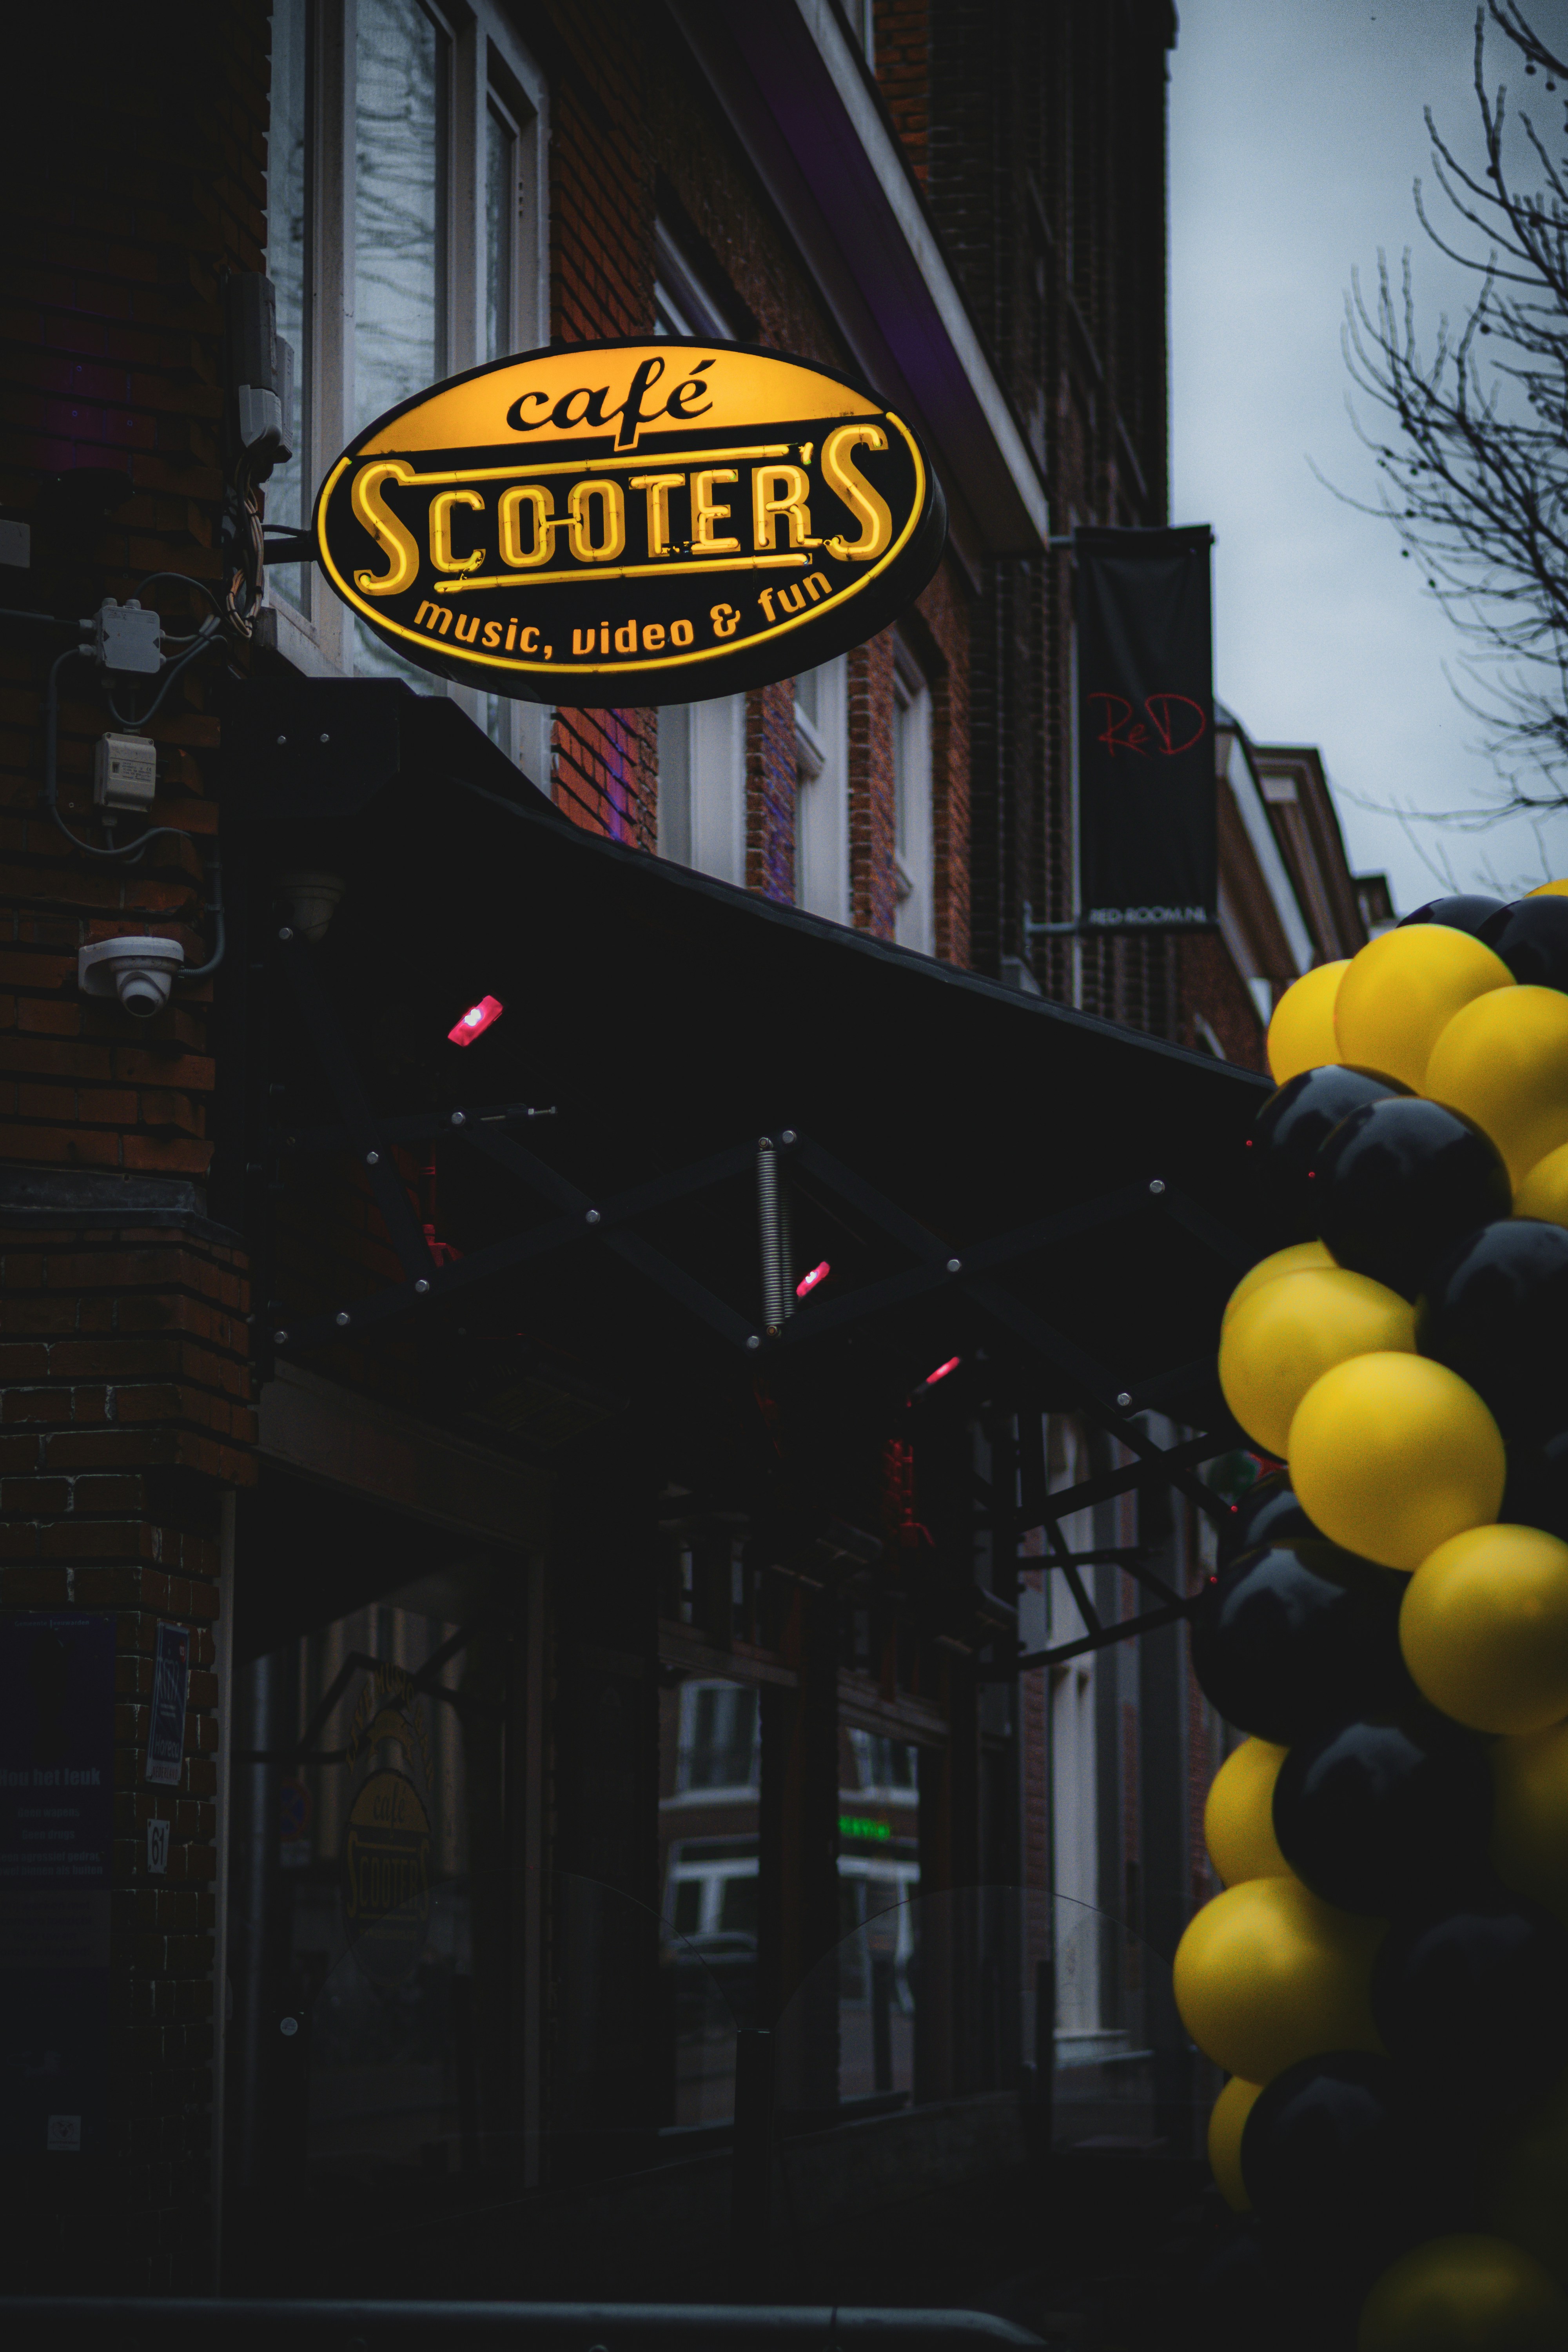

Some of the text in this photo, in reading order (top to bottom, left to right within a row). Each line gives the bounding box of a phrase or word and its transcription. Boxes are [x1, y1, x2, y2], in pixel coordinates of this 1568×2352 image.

[506, 356, 717, 452] café
[351, 424, 893, 596] SCOOTER'S
[414, 572, 833, 659] music, video & fun
[154, 1734, 180, 1759] Horeca
[33, 1768, 60, 1786] het
[64, 1768, 101, 1785] leuk
[152, 1765, 178, 1780] NEDERLAND
[18, 1808, 80, 1818] Geen wapens
[22, 1829, 75, 1840] Geen drugs
[152, 1827, 164, 1865] 61
[0, 1853, 19, 1862] een
[21, 1865, 54, 1875] binnen
[56, 1865, 70, 1875] als
[72, 1864, 103, 1875] buiten
